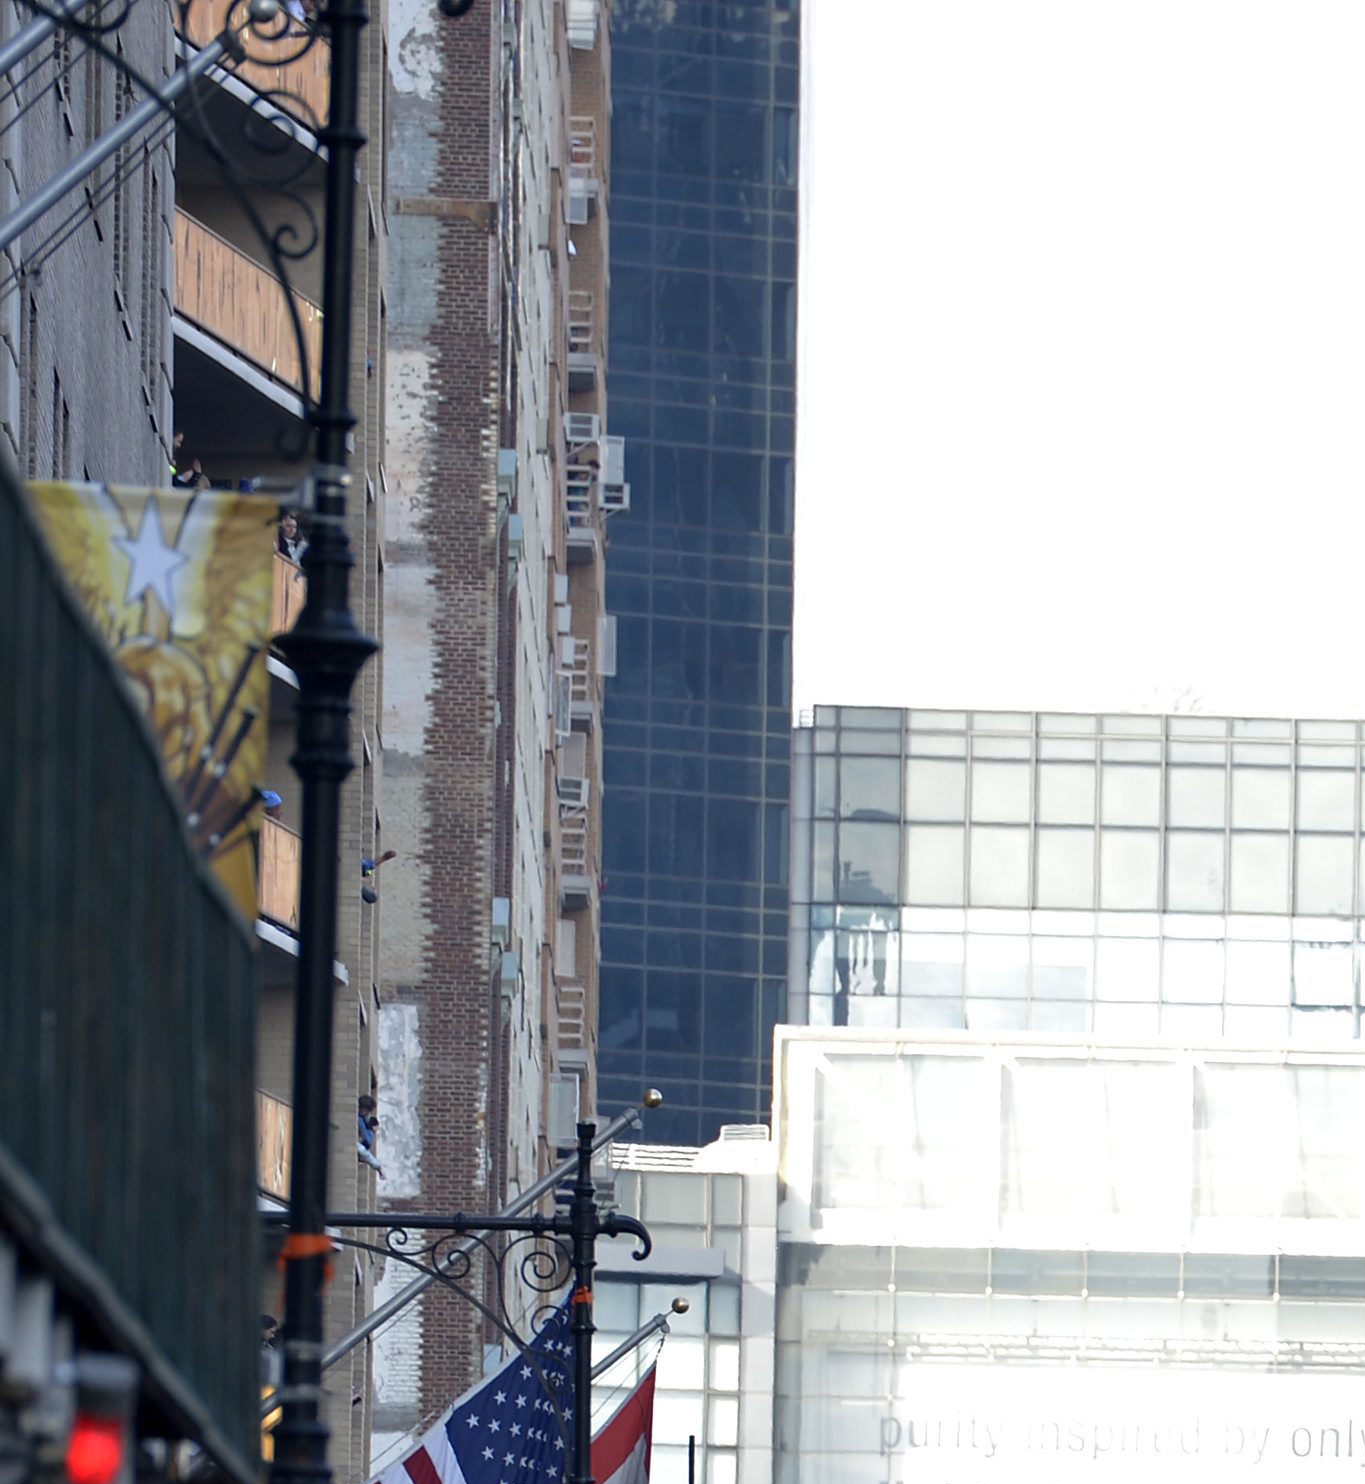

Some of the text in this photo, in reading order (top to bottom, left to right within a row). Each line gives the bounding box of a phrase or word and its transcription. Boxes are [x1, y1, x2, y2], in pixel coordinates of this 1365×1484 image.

[879, 1409, 1002, 1458] purity
[1027, 1415, 1200, 1461] inspired
[1224, 1414, 1270, 1464] by
